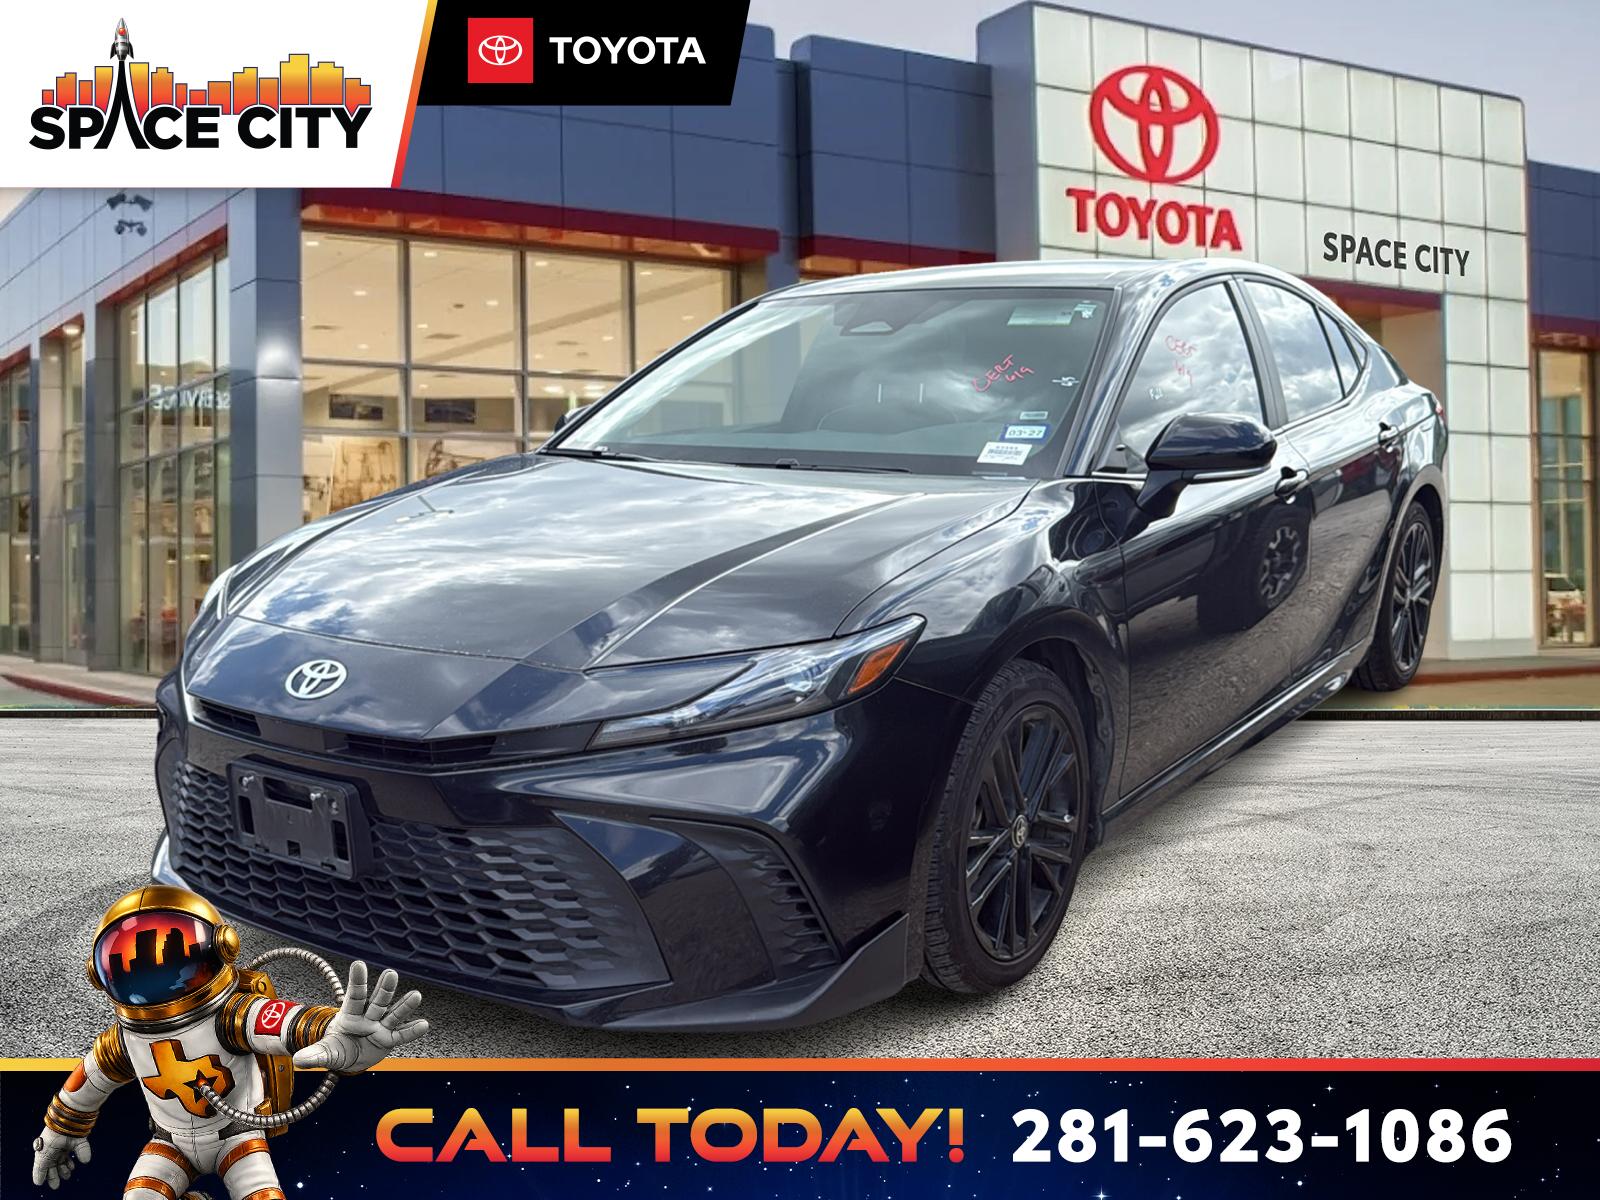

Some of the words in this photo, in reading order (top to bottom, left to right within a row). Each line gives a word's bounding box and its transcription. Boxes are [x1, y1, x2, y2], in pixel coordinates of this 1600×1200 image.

[1065, 188, 1242, 251] TOYOTA
[1323, 232, 1407, 270] SPACE
[1414, 244, 1470, 277] CITY
